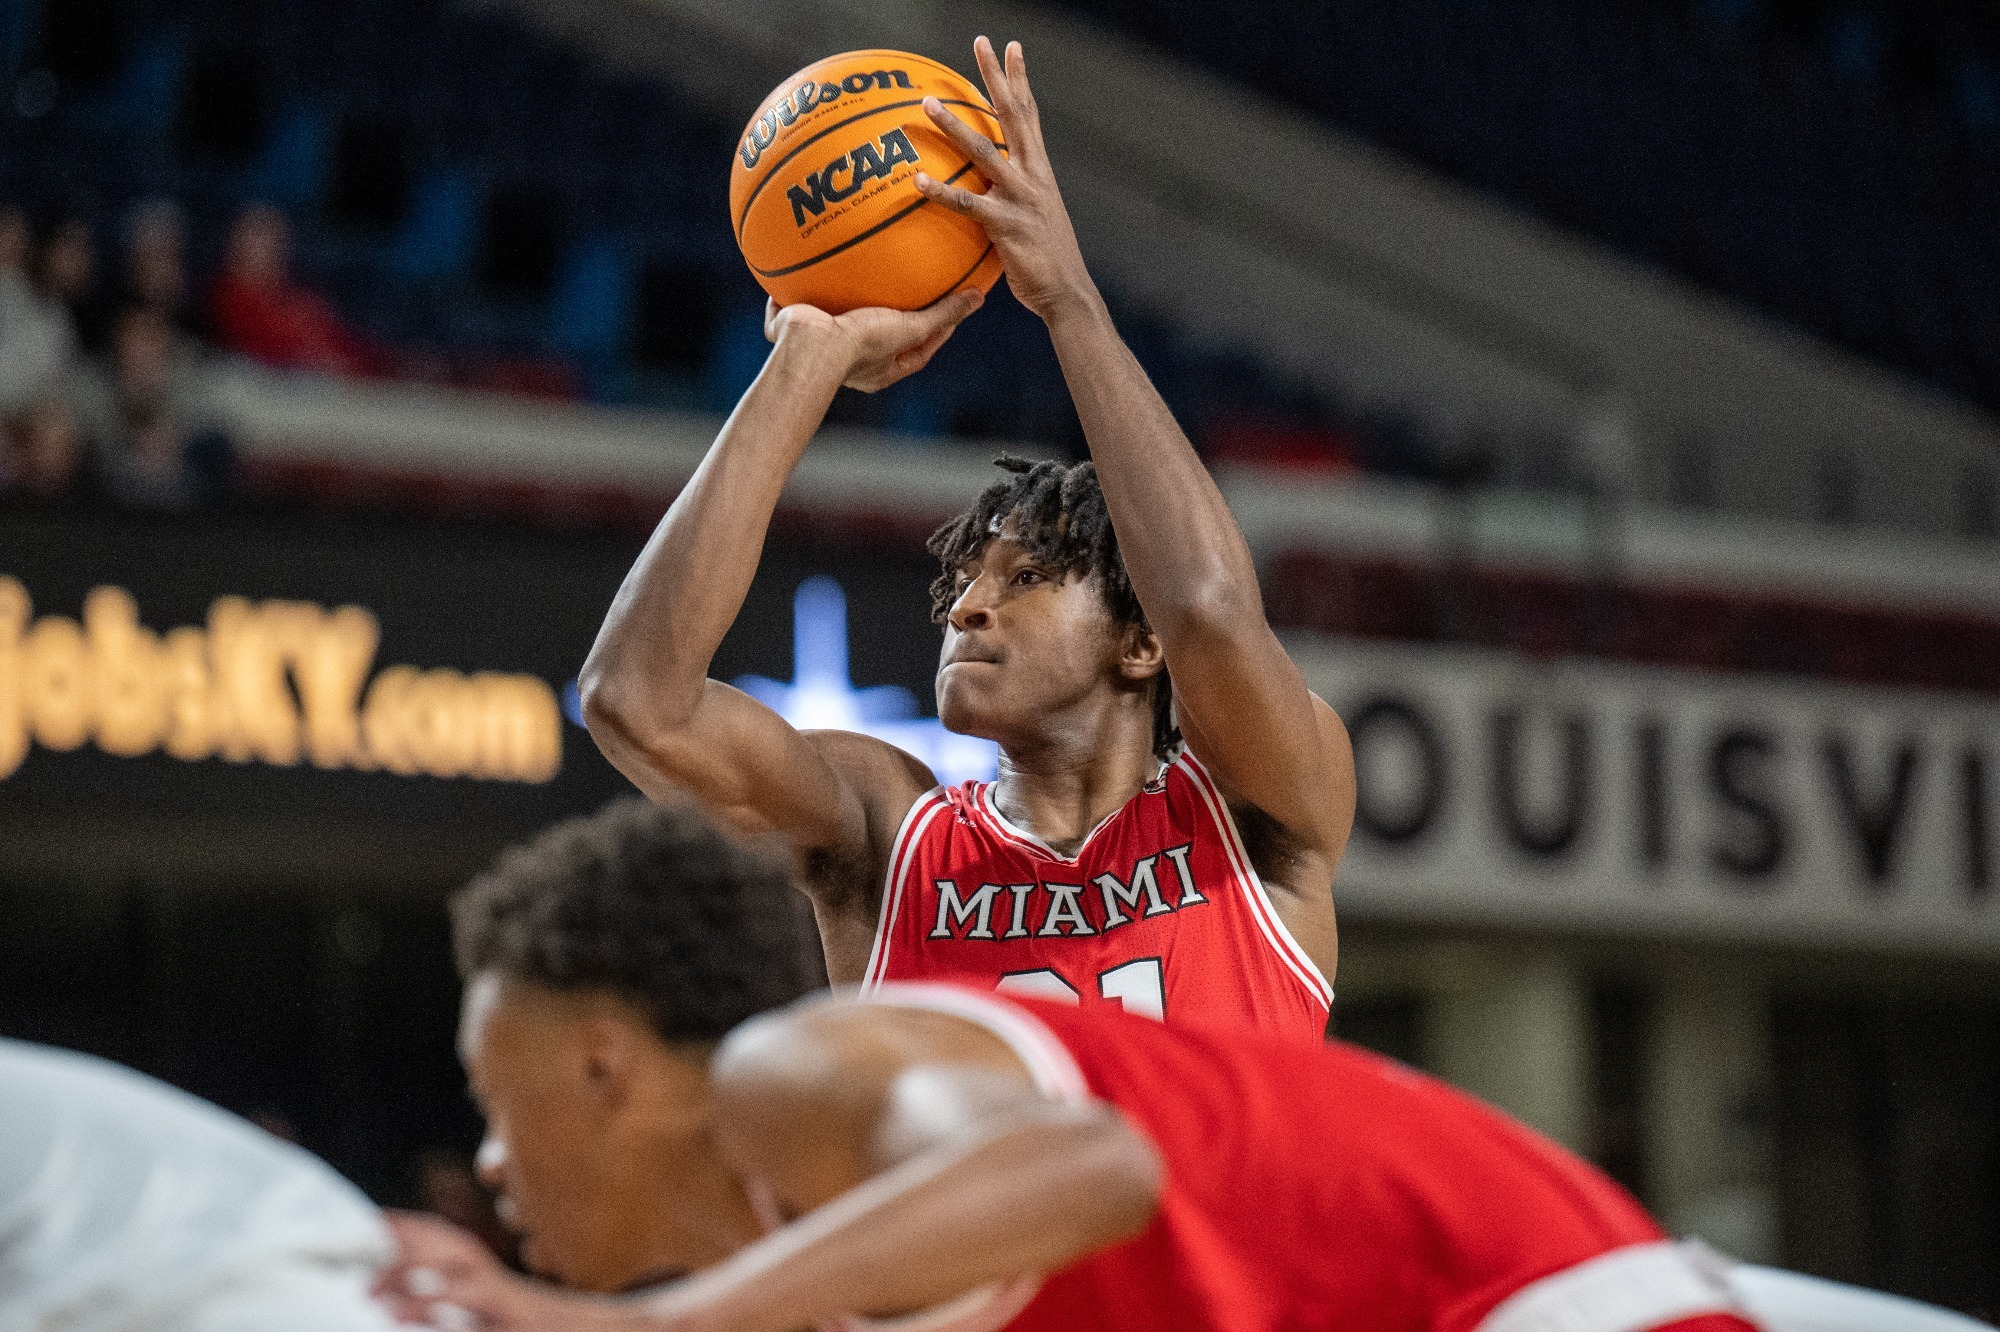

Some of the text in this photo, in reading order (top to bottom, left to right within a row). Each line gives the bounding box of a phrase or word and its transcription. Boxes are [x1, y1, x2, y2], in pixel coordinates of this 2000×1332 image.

[740, 69, 915, 170] Wilson
[786, 125, 922, 228] NCAA
[801, 166, 925, 239] OFFICIAL GAME BALL
[927, 842, 1210, 941] MIAMI
